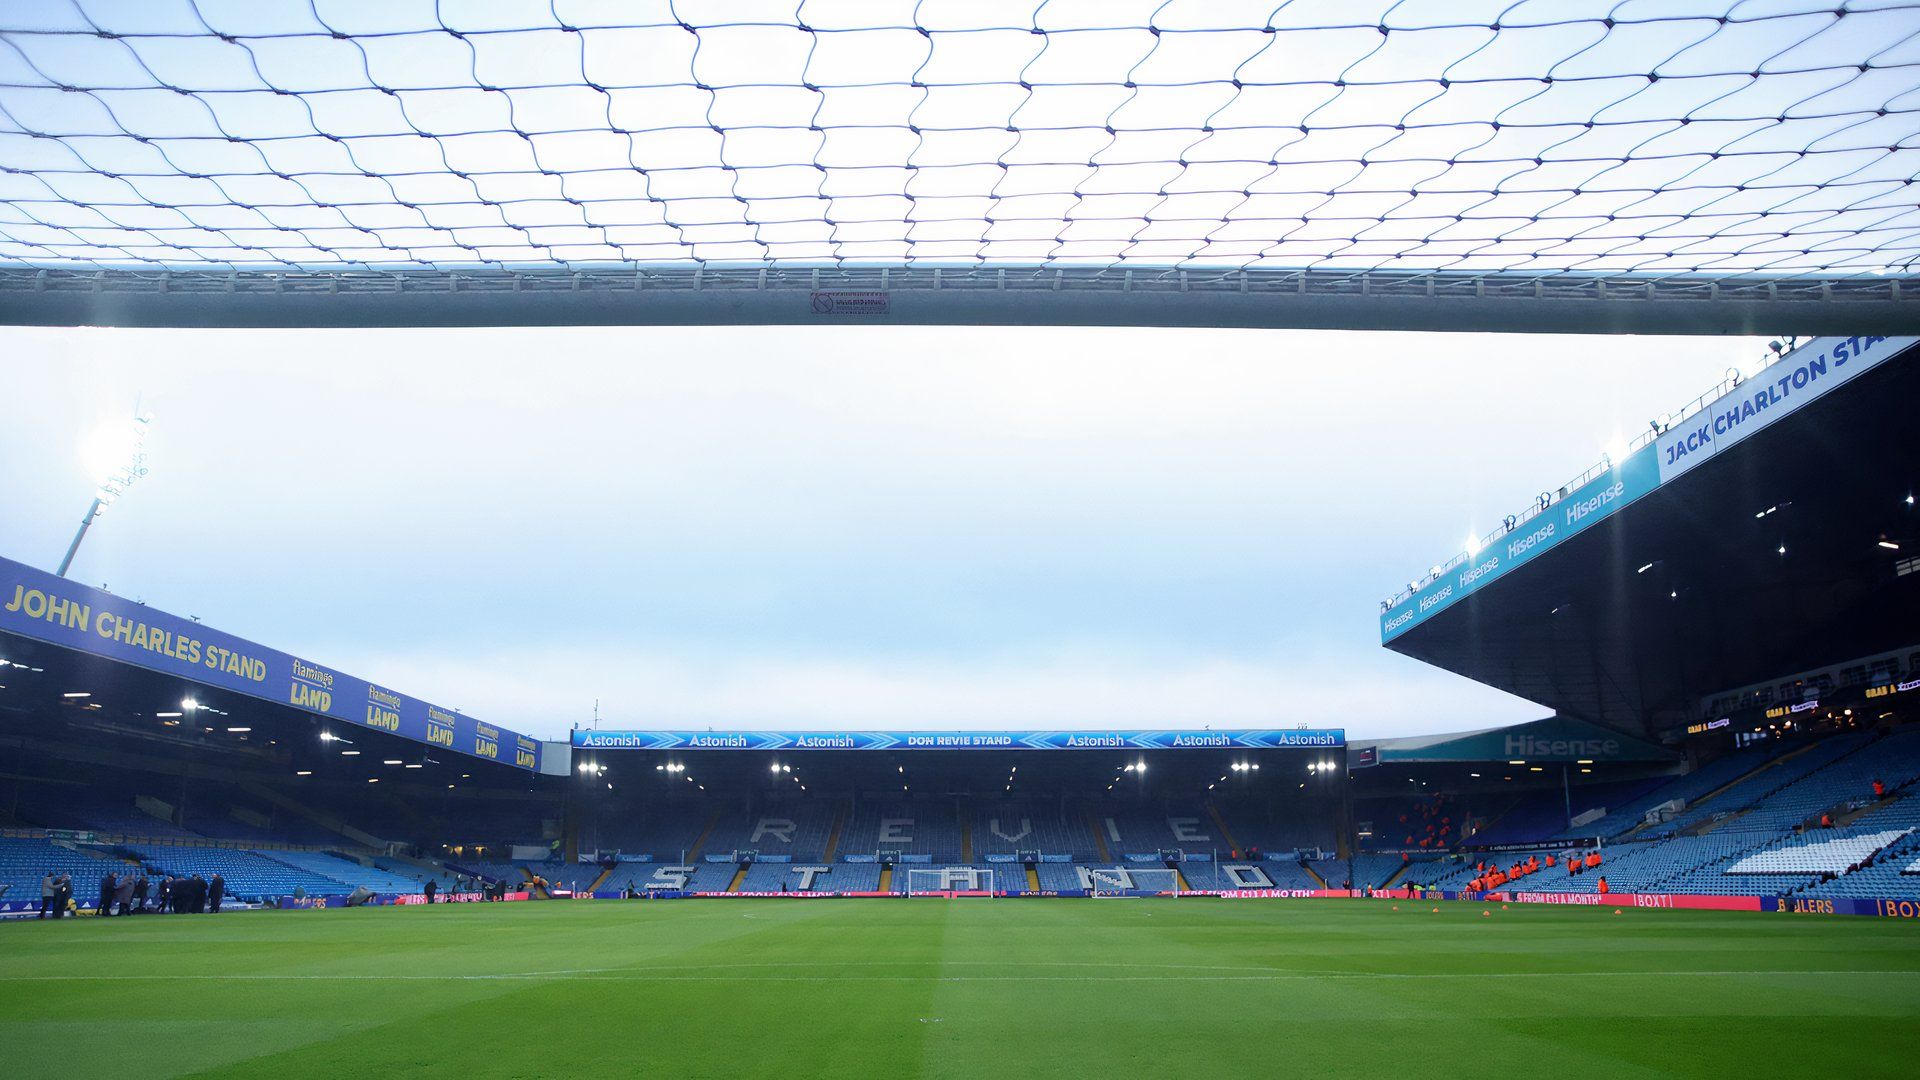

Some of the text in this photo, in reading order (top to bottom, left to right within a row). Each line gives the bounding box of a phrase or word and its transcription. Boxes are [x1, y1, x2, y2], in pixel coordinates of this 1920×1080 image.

[1666, 336, 1892, 465] JACK CHARLTON STA
[1566, 480, 1624, 525] Hisense
[1508, 521, 1555, 560] Hisense
[1460, 556, 1499, 588] Hisense
[1419, 583, 1452, 613] Hisense
[5, 585, 266, 681] JOHN CHARLES STAND
[1384, 609, 1413, 633] Hisense
[293, 658, 333, 688] flamingo
[290, 683, 332, 712] LAND
[366, 705, 399, 731] LAND
[583, 734, 640, 746] Astonish
[689, 734, 746, 746] Astonish
[796, 734, 854, 747] Astonish
[908, 736, 1011, 745] DON REVIE STAND
[1067, 734, 1124, 746] Astonish
[1173, 733, 1230, 746] Astonish
[1278, 732, 1335, 745] Astonish
[1505, 734, 1619, 756] Hisense
[1778, 898, 1834, 914] BILERS
